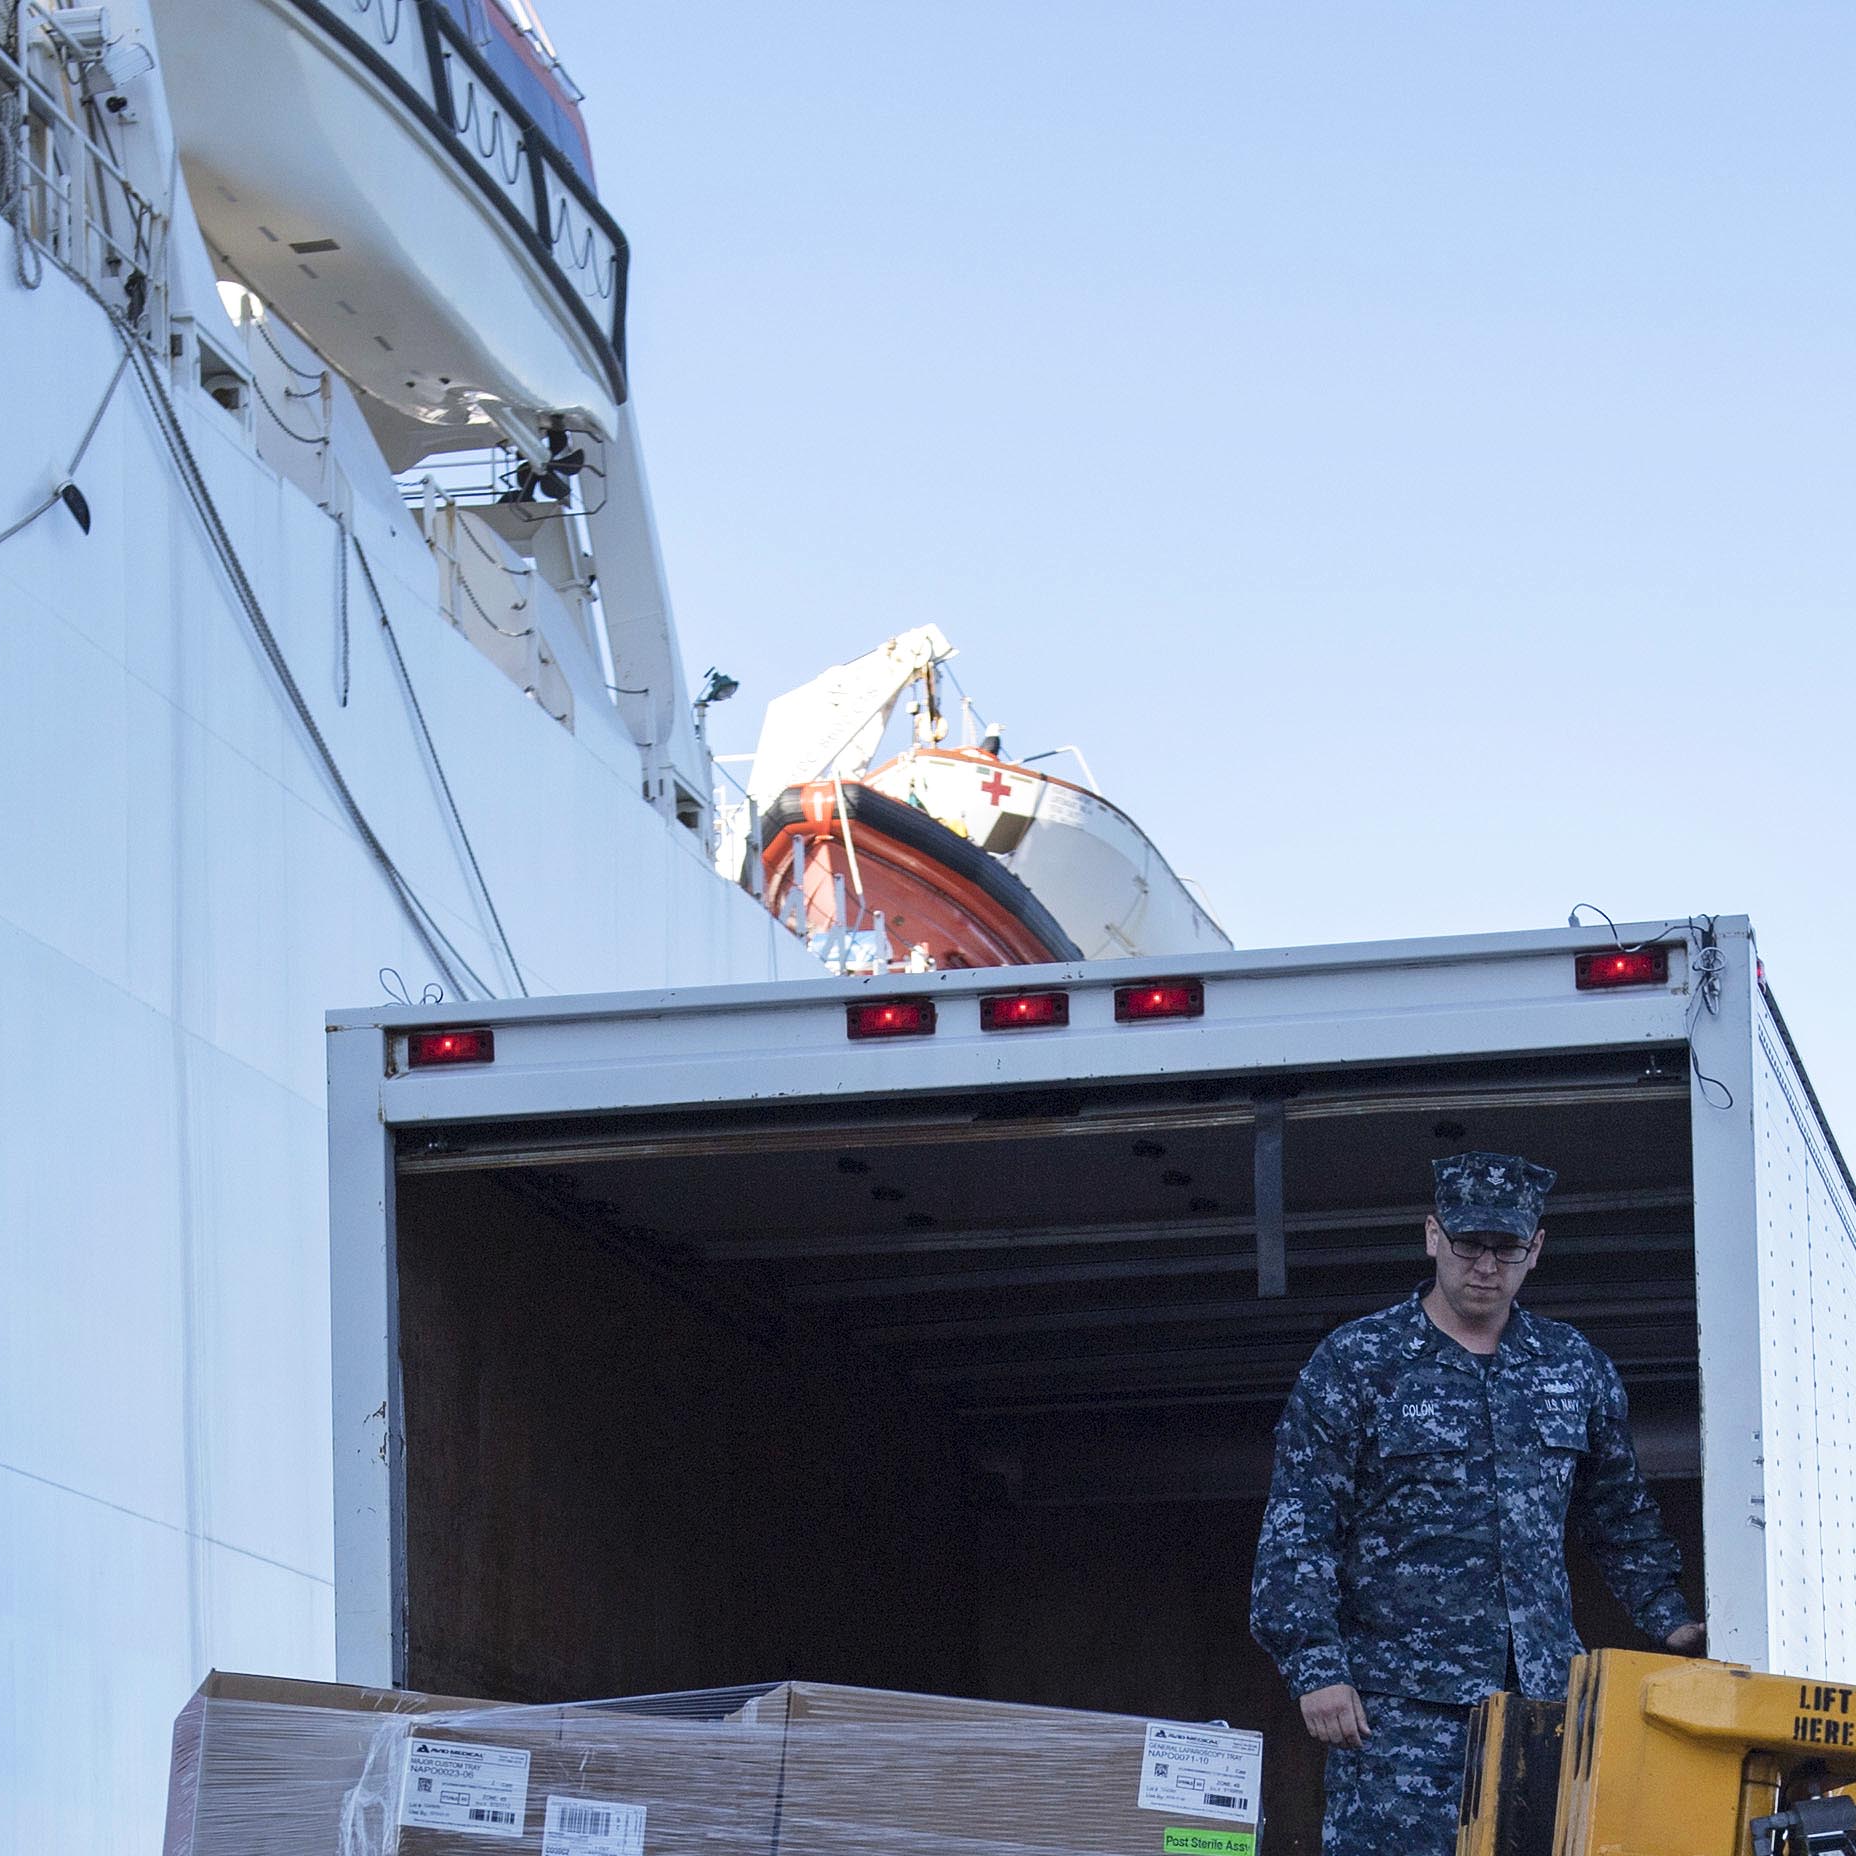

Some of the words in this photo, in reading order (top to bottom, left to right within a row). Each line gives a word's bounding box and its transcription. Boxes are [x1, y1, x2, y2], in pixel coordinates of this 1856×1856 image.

[1560, 1399, 1580, 1412] NAVY
[1800, 1685, 1852, 1713] LIFT
[1793, 1716, 1854, 1746] HERE
[450, 1750, 483, 1758] MEDICAL
[1148, 1742, 1178, 1753] GENERAL
[1179, 1745, 1225, 1759] LAPAROSCOPY
[1226, 1752, 1243, 1761] TRAY
[410, 1758, 433, 1766] MAJOR
[435, 1760, 464, 1769] CUSTOM
[464, 1763, 481, 1771] TRAY
[1166, 1835, 1189, 1848] Post
[1191, 1837, 1223, 1850] Sterile
[1225, 1840, 1250, 1856] Assy
